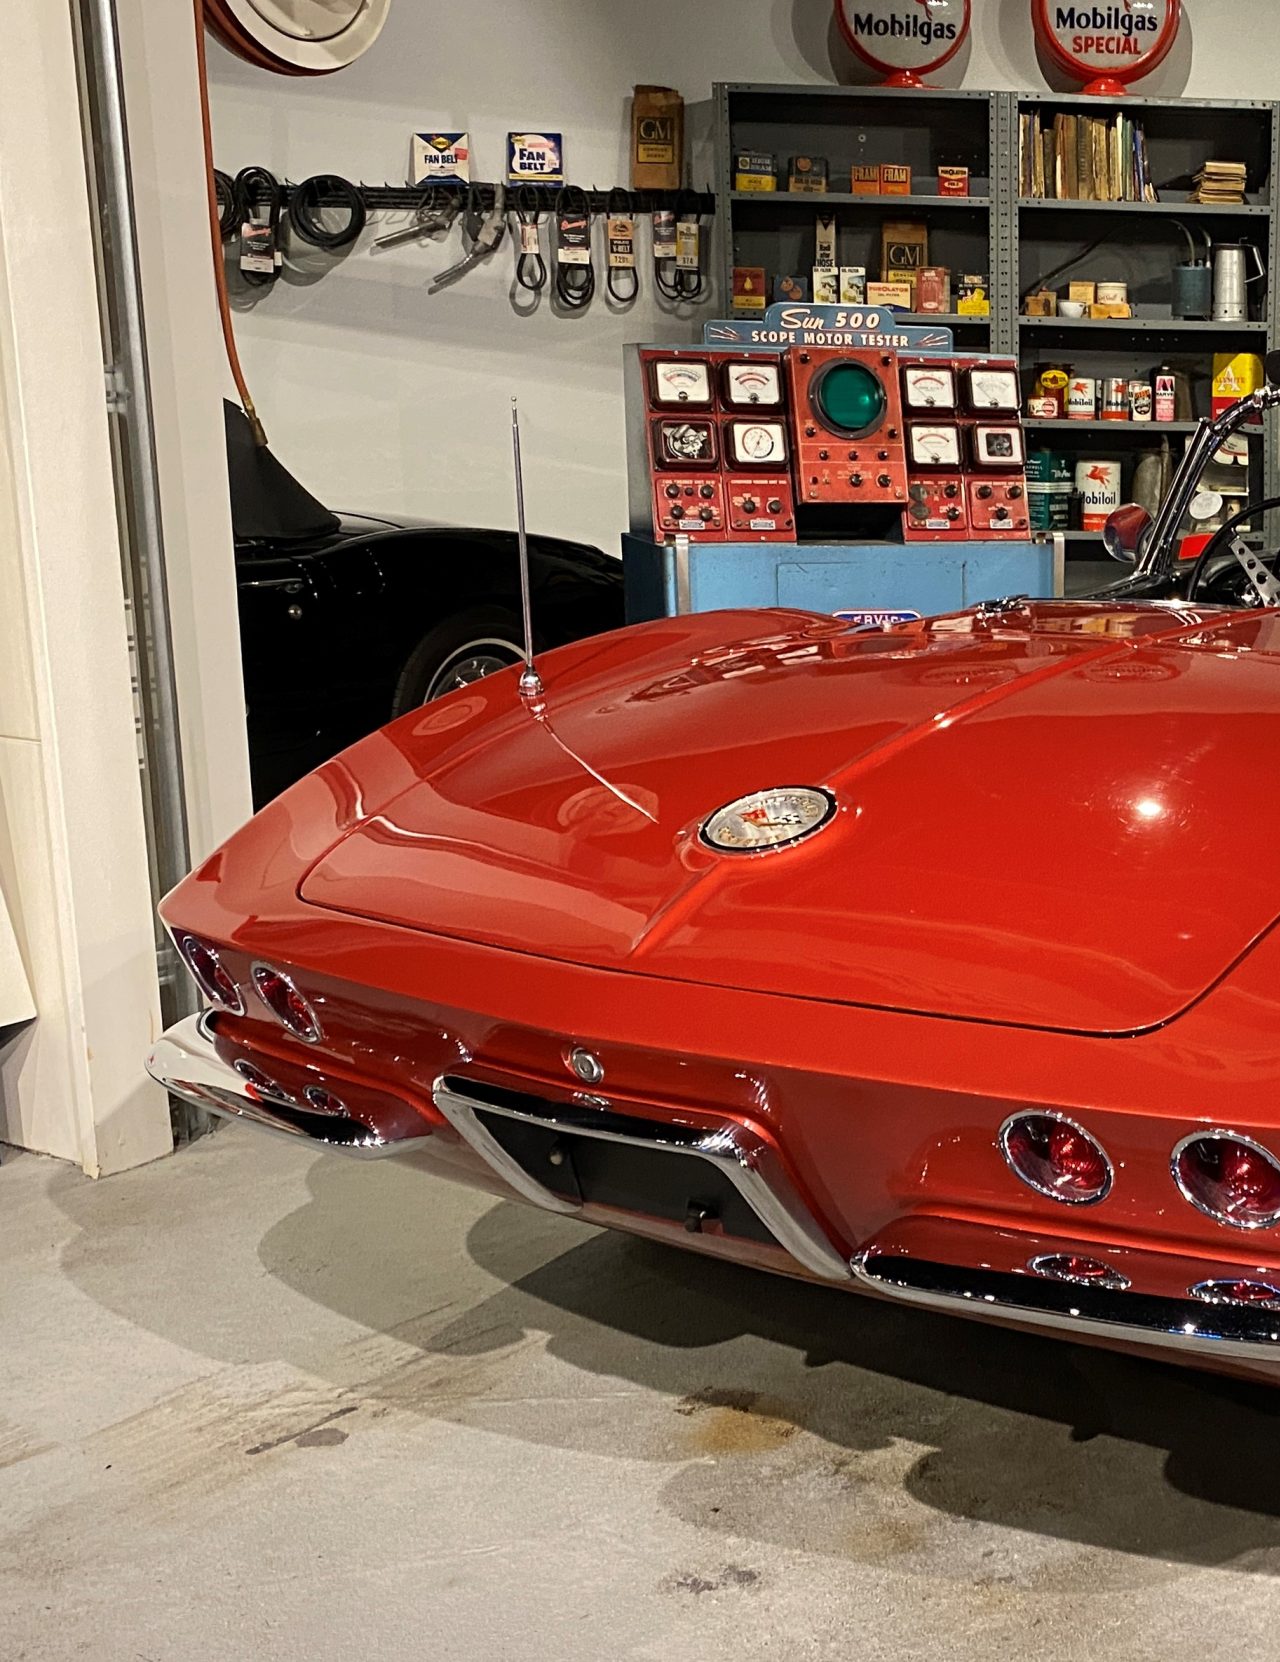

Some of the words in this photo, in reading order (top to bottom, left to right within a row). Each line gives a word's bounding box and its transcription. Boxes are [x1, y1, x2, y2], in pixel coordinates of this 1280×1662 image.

[853, 13, 957, 45] Mobilgas
[1055, 7, 1158, 37] Mobilgas
[1072, 35, 1142, 55] SPECIAL
[640, 119, 671, 140] GM
[424, 154, 439, 163] FAN
[441, 154, 458, 164] BELT
[519, 148, 546, 161] FAN
[519, 162, 546, 171] BELT
[855, 167, 877, 180] FRAM
[884, 168, 907, 182] FRAM
[890, 245, 920, 266] GM
[780, 308, 823, 330] Sun
[835, 312, 880, 329] 500
[752, 331, 796, 343] SCOPE
[804, 332, 853, 345] MOTOR
[860, 333, 909, 347] TESTER
